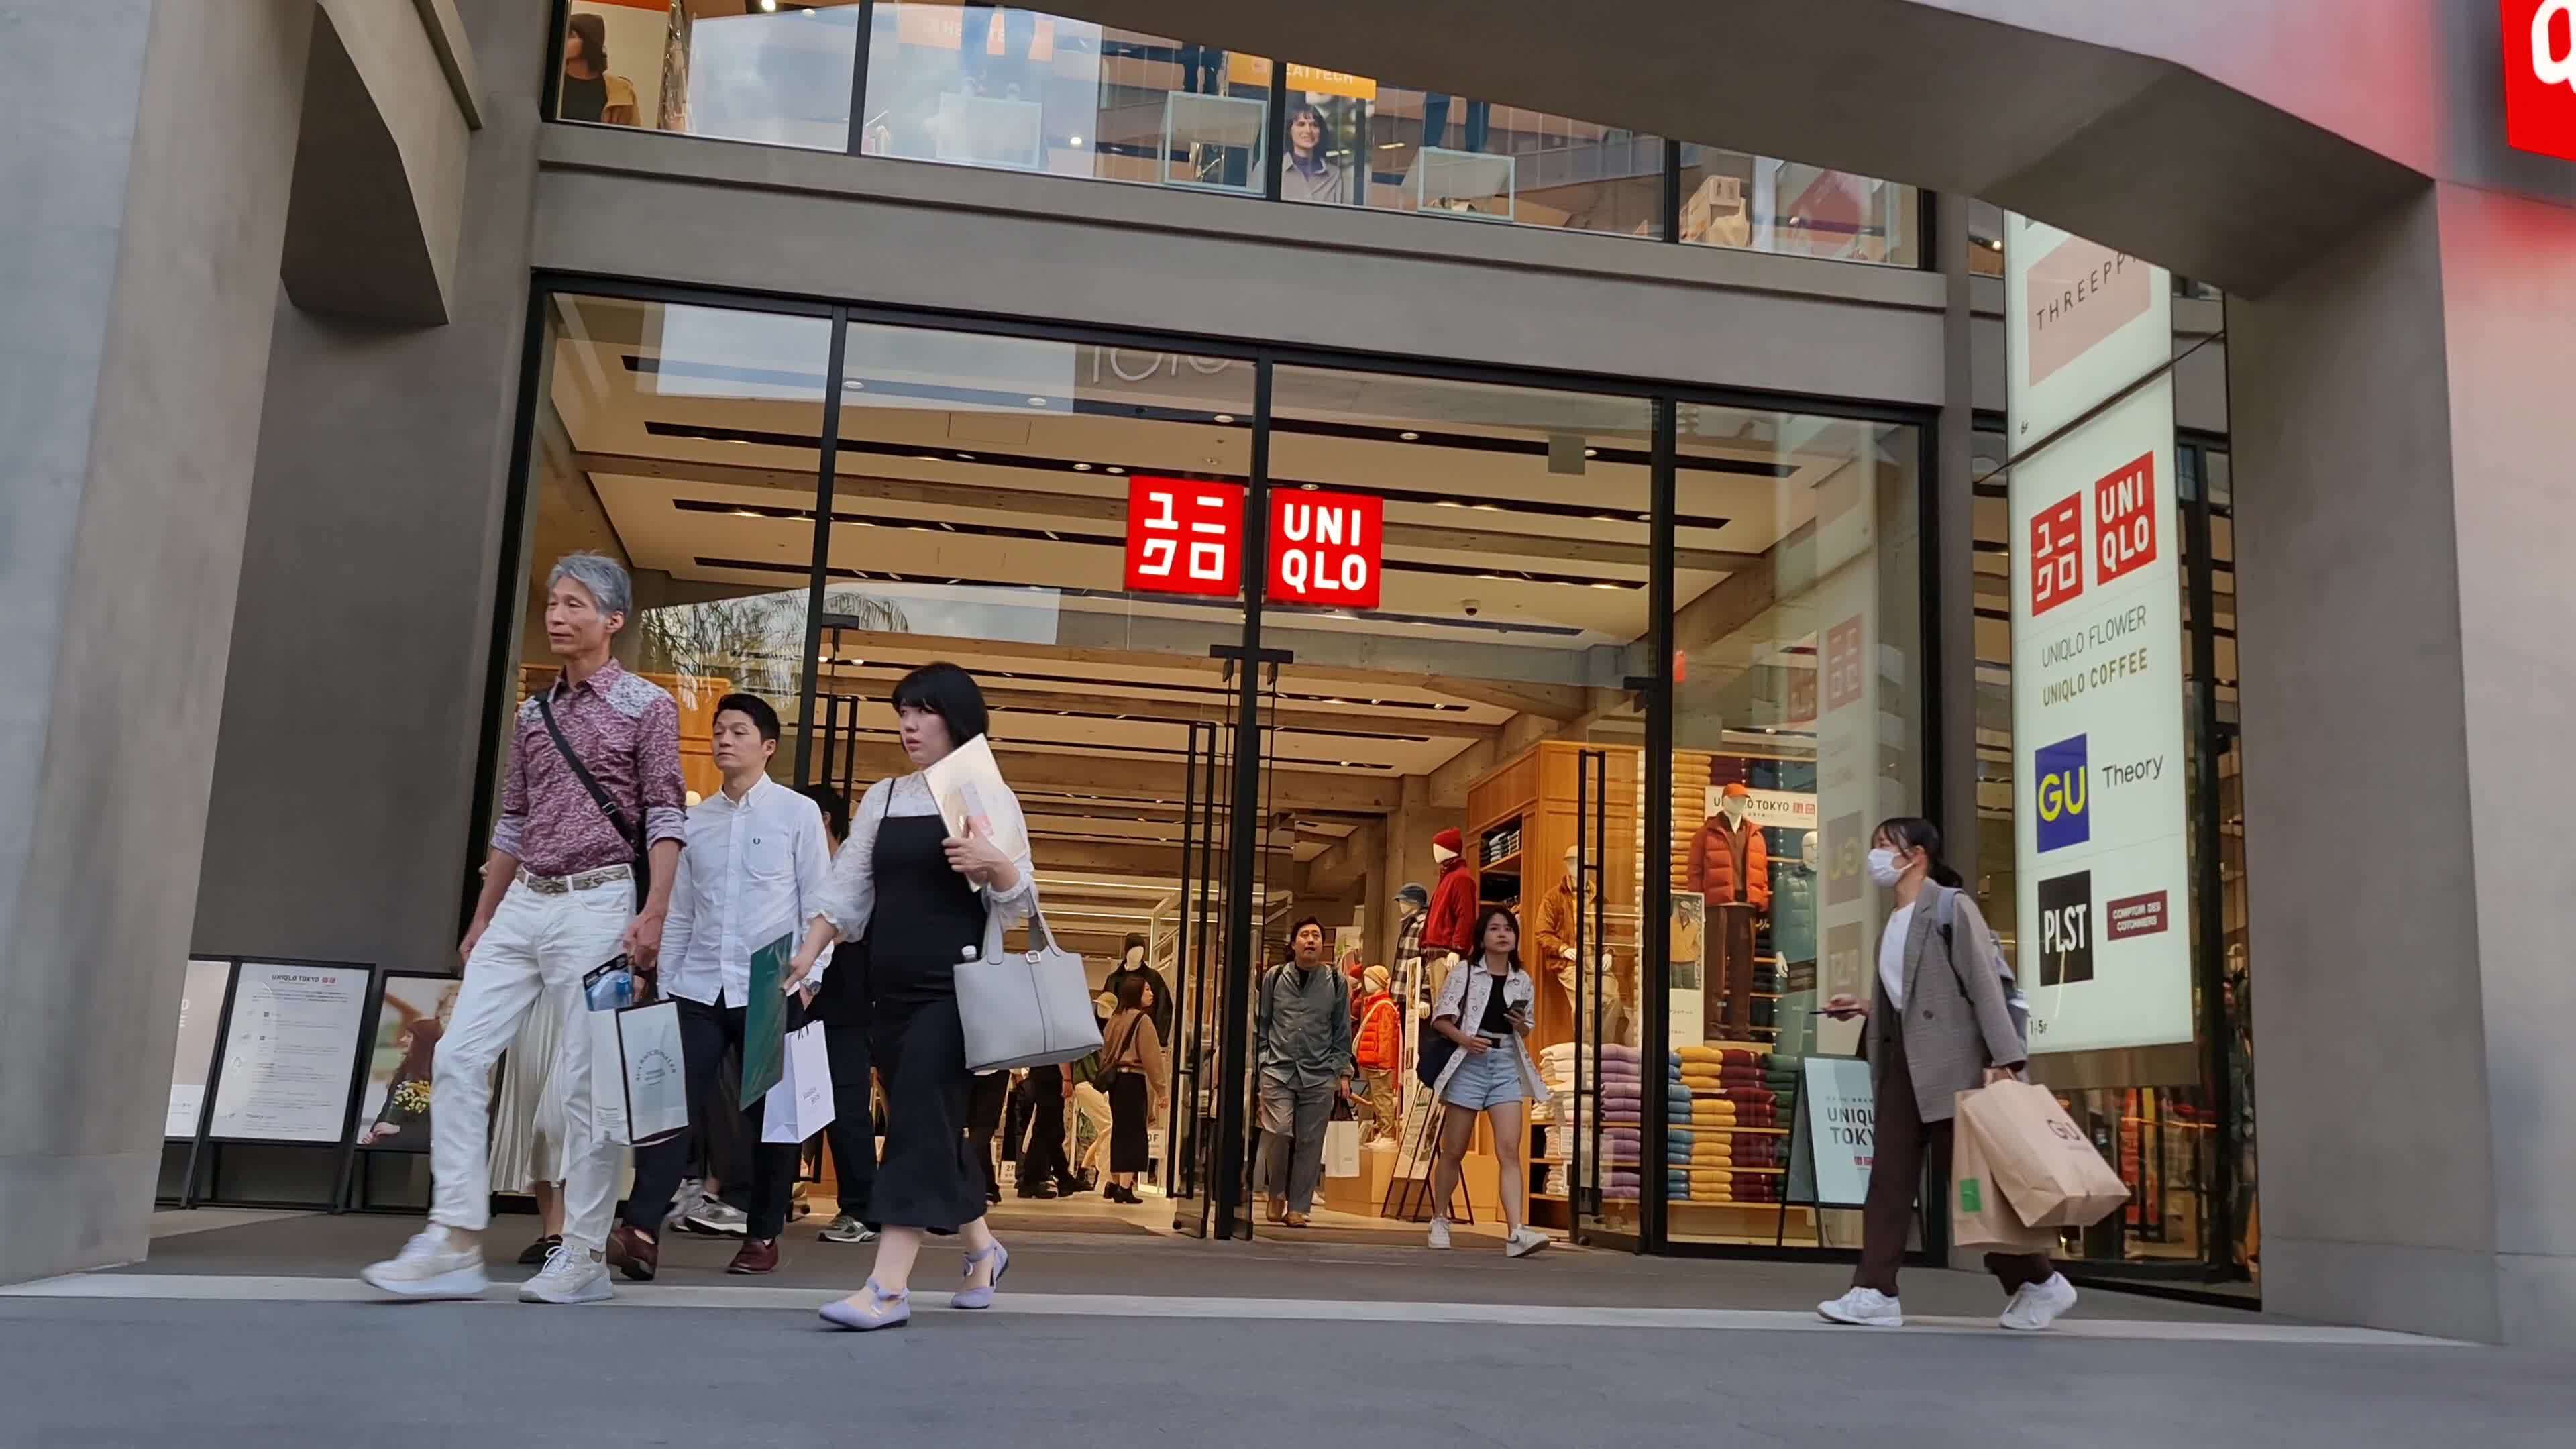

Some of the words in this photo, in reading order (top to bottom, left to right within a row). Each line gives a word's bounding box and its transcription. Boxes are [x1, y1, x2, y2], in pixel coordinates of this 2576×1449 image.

[2035, 252, 2137, 331] THREEPP
[1144, 492, 1226, 535] ユニ
[2101, 472, 2143, 524] UNI
[1283, 504, 1361, 546] UNI
[2037, 508, 2076, 558] ユニ
[2102, 515, 2149, 573] QLO
[1139, 538, 1225, 580] クロ
[1281, 549, 1368, 594] QLO
[2037, 551, 2076, 602] クロ
[2042, 632, 2084, 668] UNIQLO
[2089, 605, 2147, 649] FLOWER
[2043, 673, 2084, 707] UNIQLO
[2090, 647, 2148, 688] COFFEE
[2038, 767, 2086, 822] GU
[2102, 755, 2163, 789] Theory
[1757, 799, 1789, 811] TOKYO
[2044, 904, 2086, 955] PLST
[2047, 1119, 2080, 1141] GU
